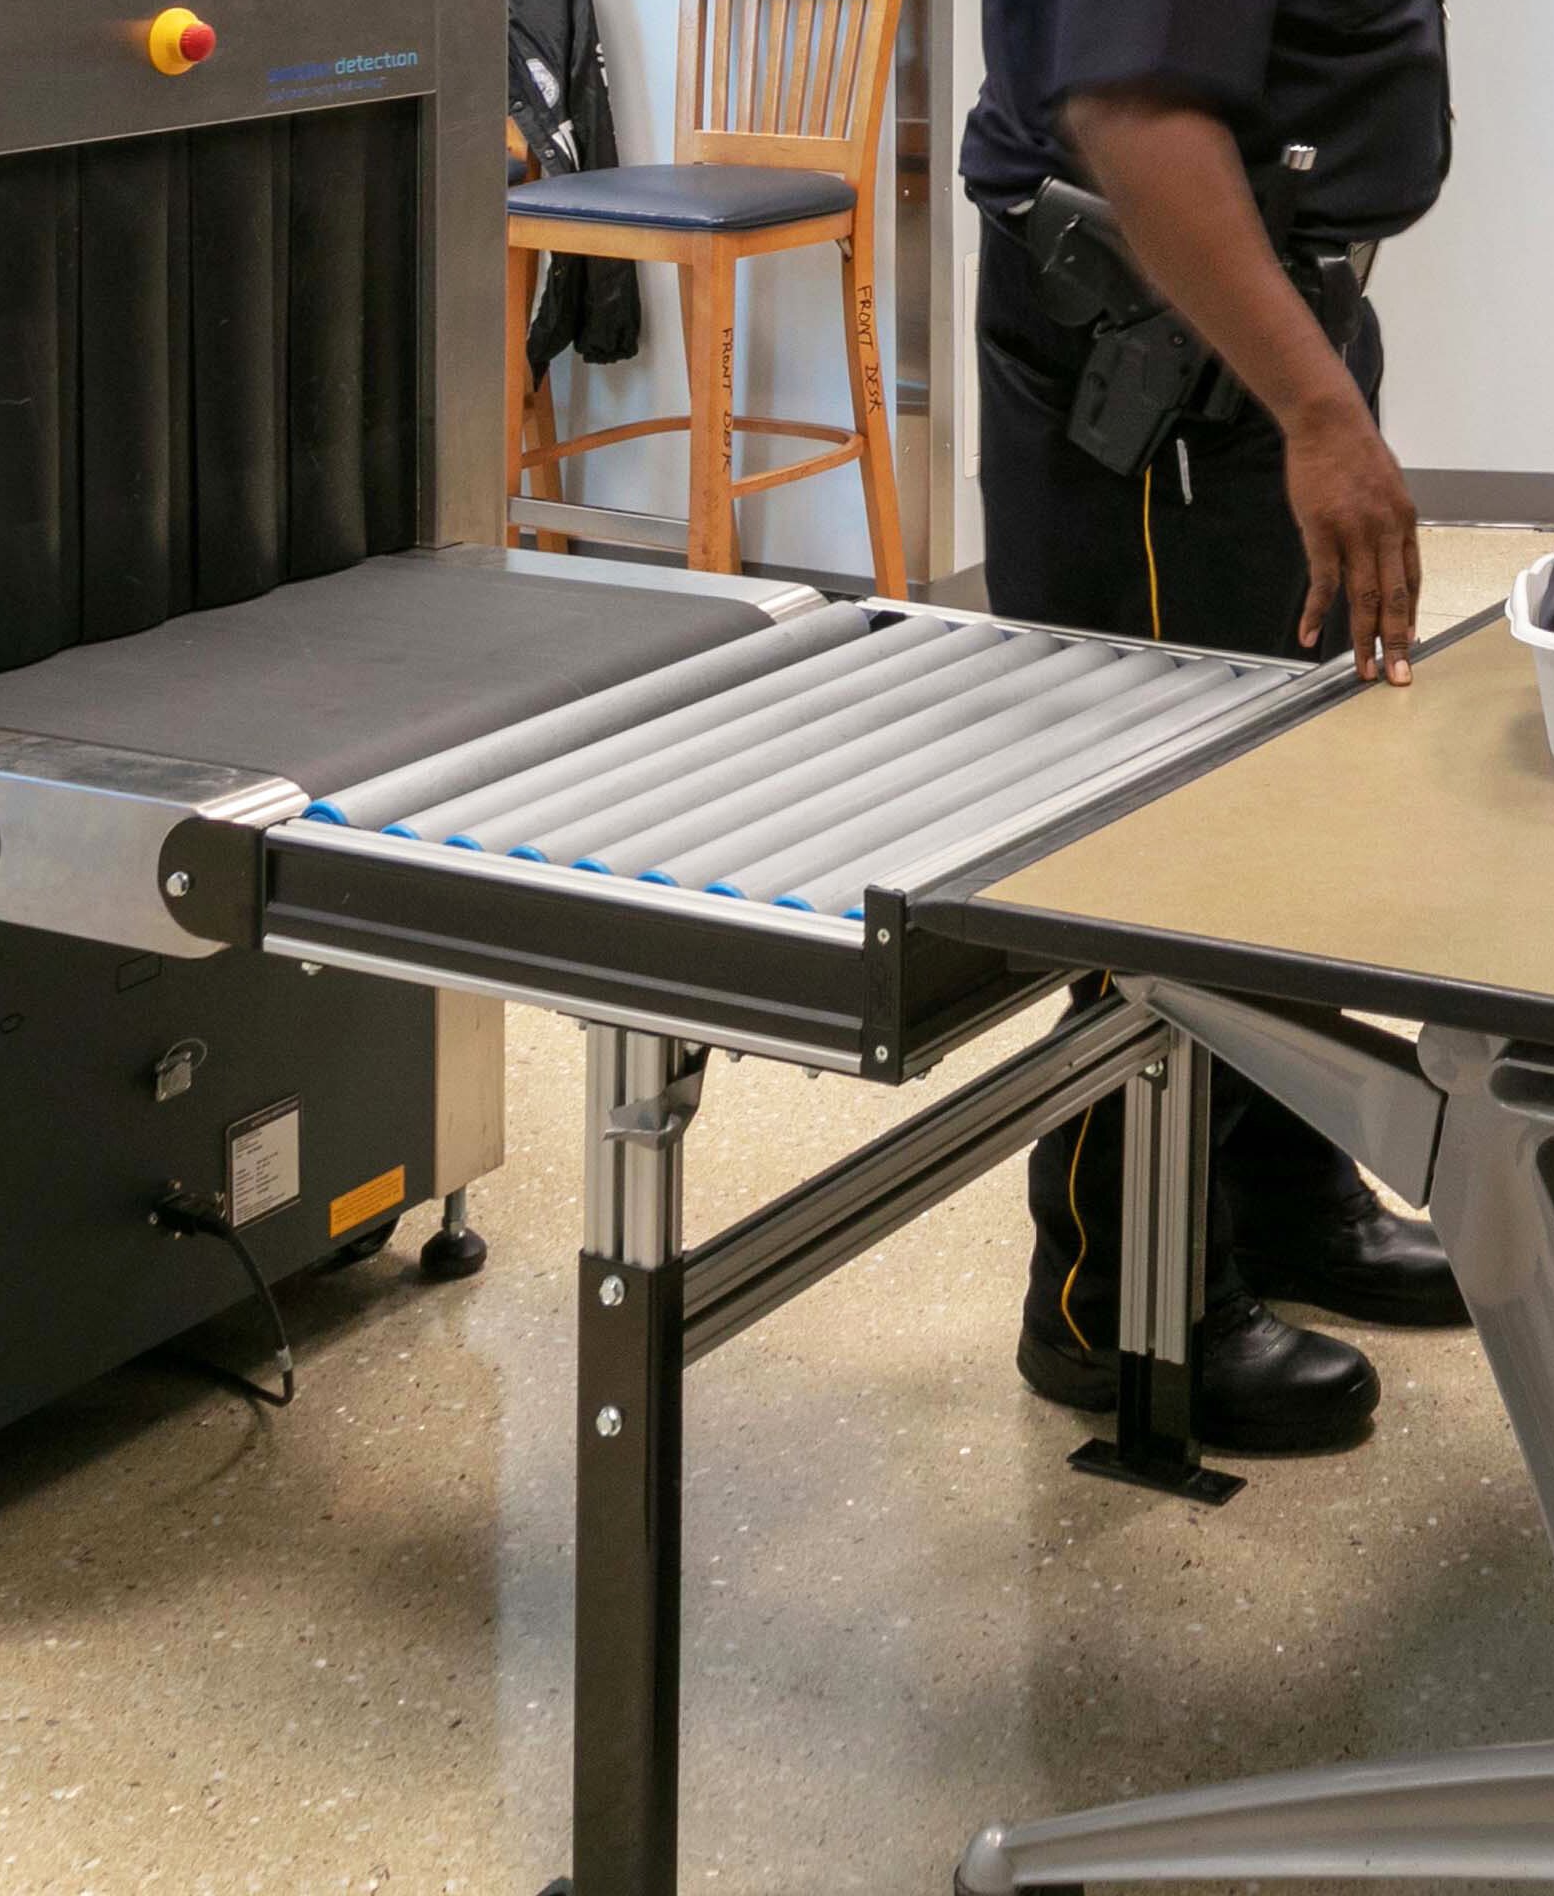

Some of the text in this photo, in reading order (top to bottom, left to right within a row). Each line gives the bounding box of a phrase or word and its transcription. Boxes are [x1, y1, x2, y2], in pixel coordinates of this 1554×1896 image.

[334, 51, 419, 75] detection
[721, 327, 734, 396] FRONT
[857, 284, 882, 415] FRONT DESK
